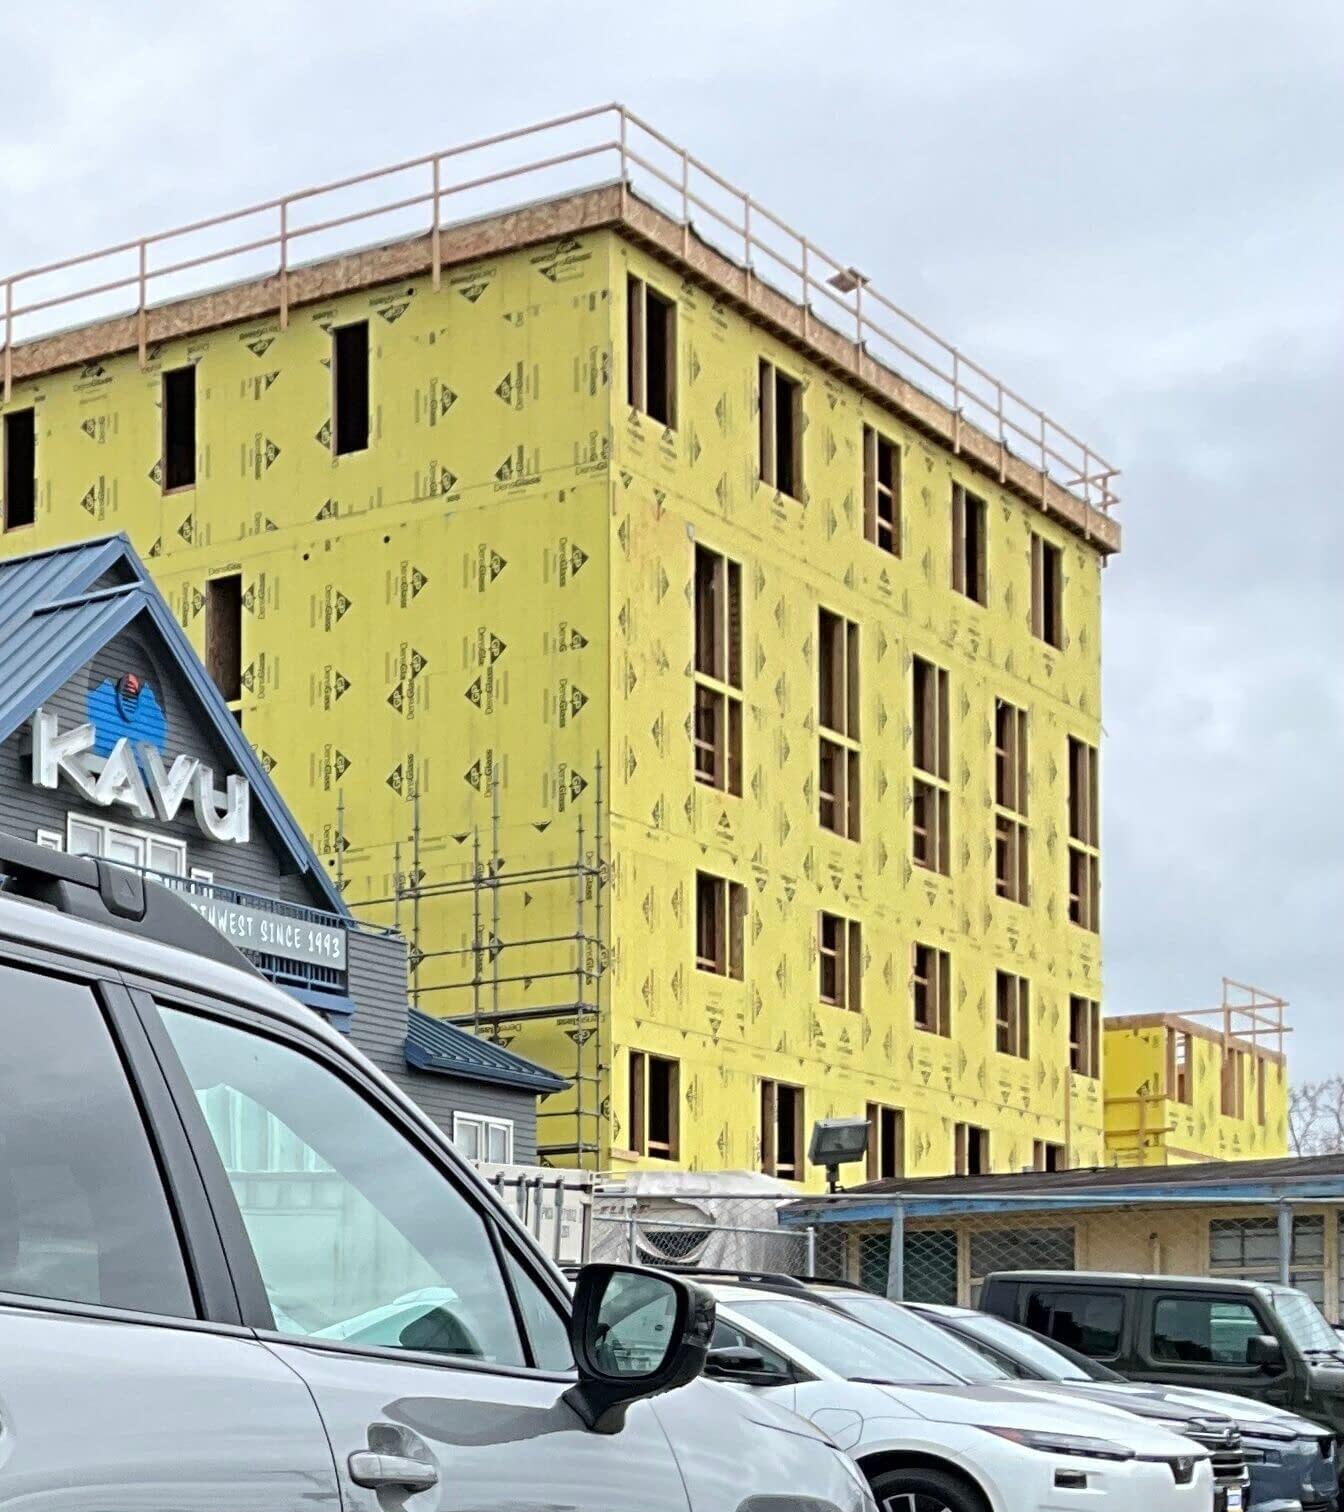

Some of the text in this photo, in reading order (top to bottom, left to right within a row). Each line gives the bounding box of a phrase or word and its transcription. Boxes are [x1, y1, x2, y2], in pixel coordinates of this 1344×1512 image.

[32, 707, 249, 843] KAVU
[261, 920, 301, 949] SINCE
[308, 931, 340, 958] 1993
